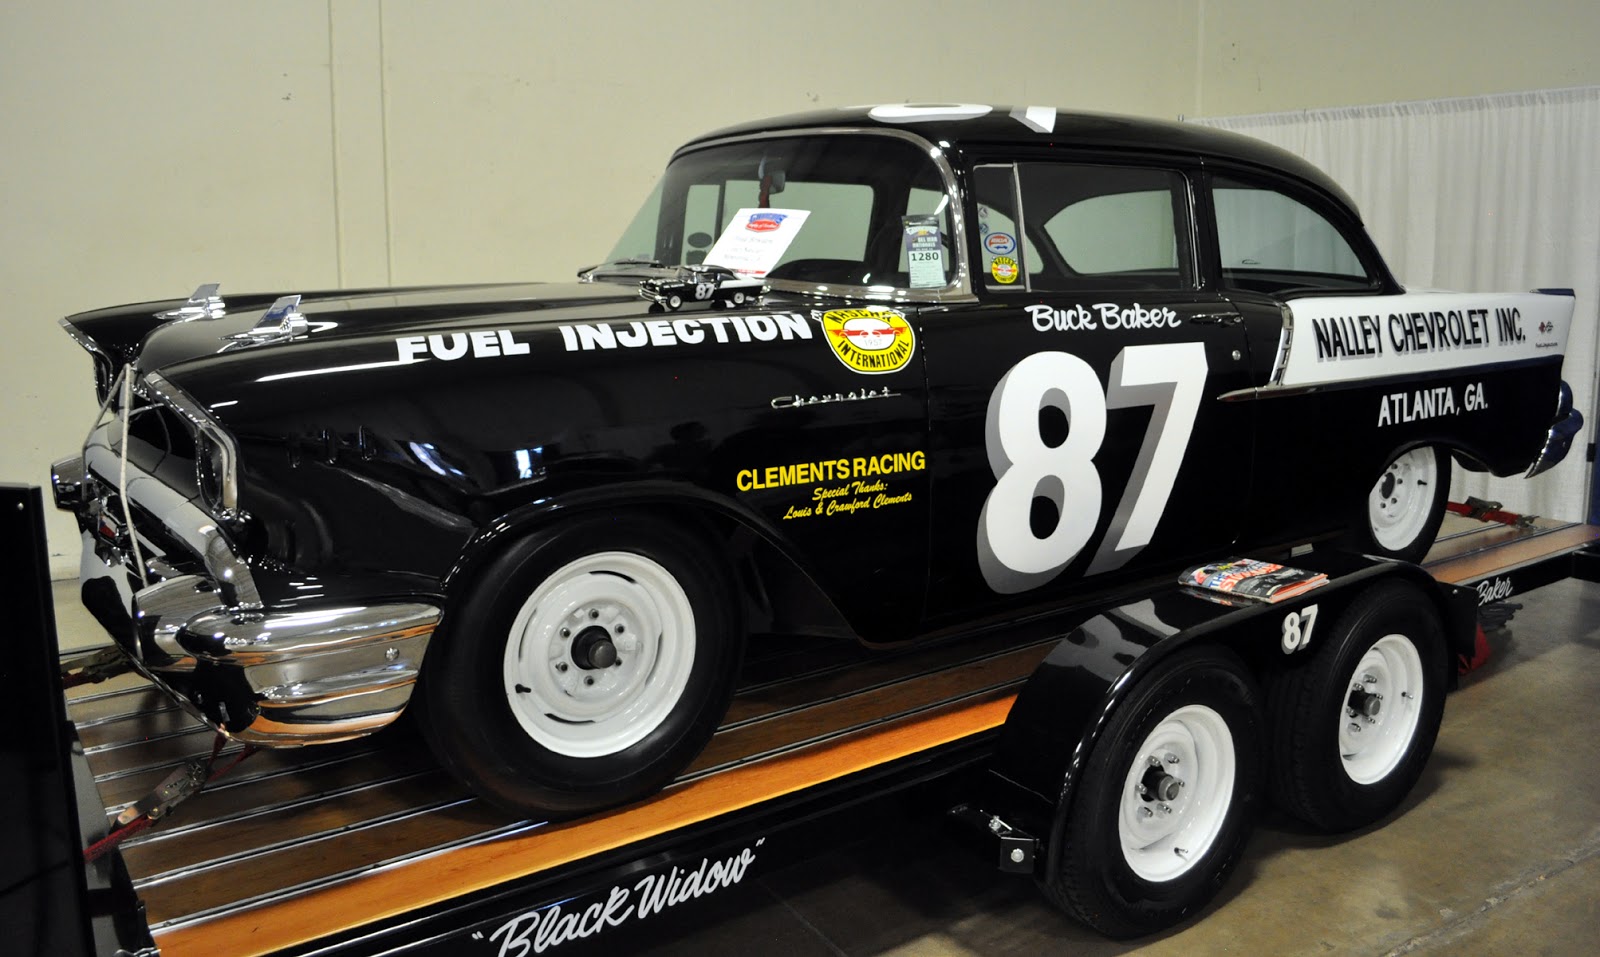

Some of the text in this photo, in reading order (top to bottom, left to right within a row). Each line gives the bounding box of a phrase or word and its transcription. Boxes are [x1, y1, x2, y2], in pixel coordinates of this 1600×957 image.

[911, 252, 939, 261] 1280
[695, 283, 715, 300] 87
[1025, 303, 1181, 331] Buck Baker
[395, 314, 812, 362] FUEL INJECTION
[1312, 307, 1527, 359] NALLEY CHEVROLET INC.
[837, 340, 909, 368] INTERNATIONAL
[1378, 382, 1488, 427] ATLANTA, GA.
[736, 450, 925, 492] CLEMENTS RACING
[977, 342, 1209, 594] 87
[811, 479, 888, 501] Special Thanks:
[783, 491, 912, 520] Louis & Crawford Clements
[1477, 577, 1513, 606] Baker
[1281, 604, 1319, 653] 87
